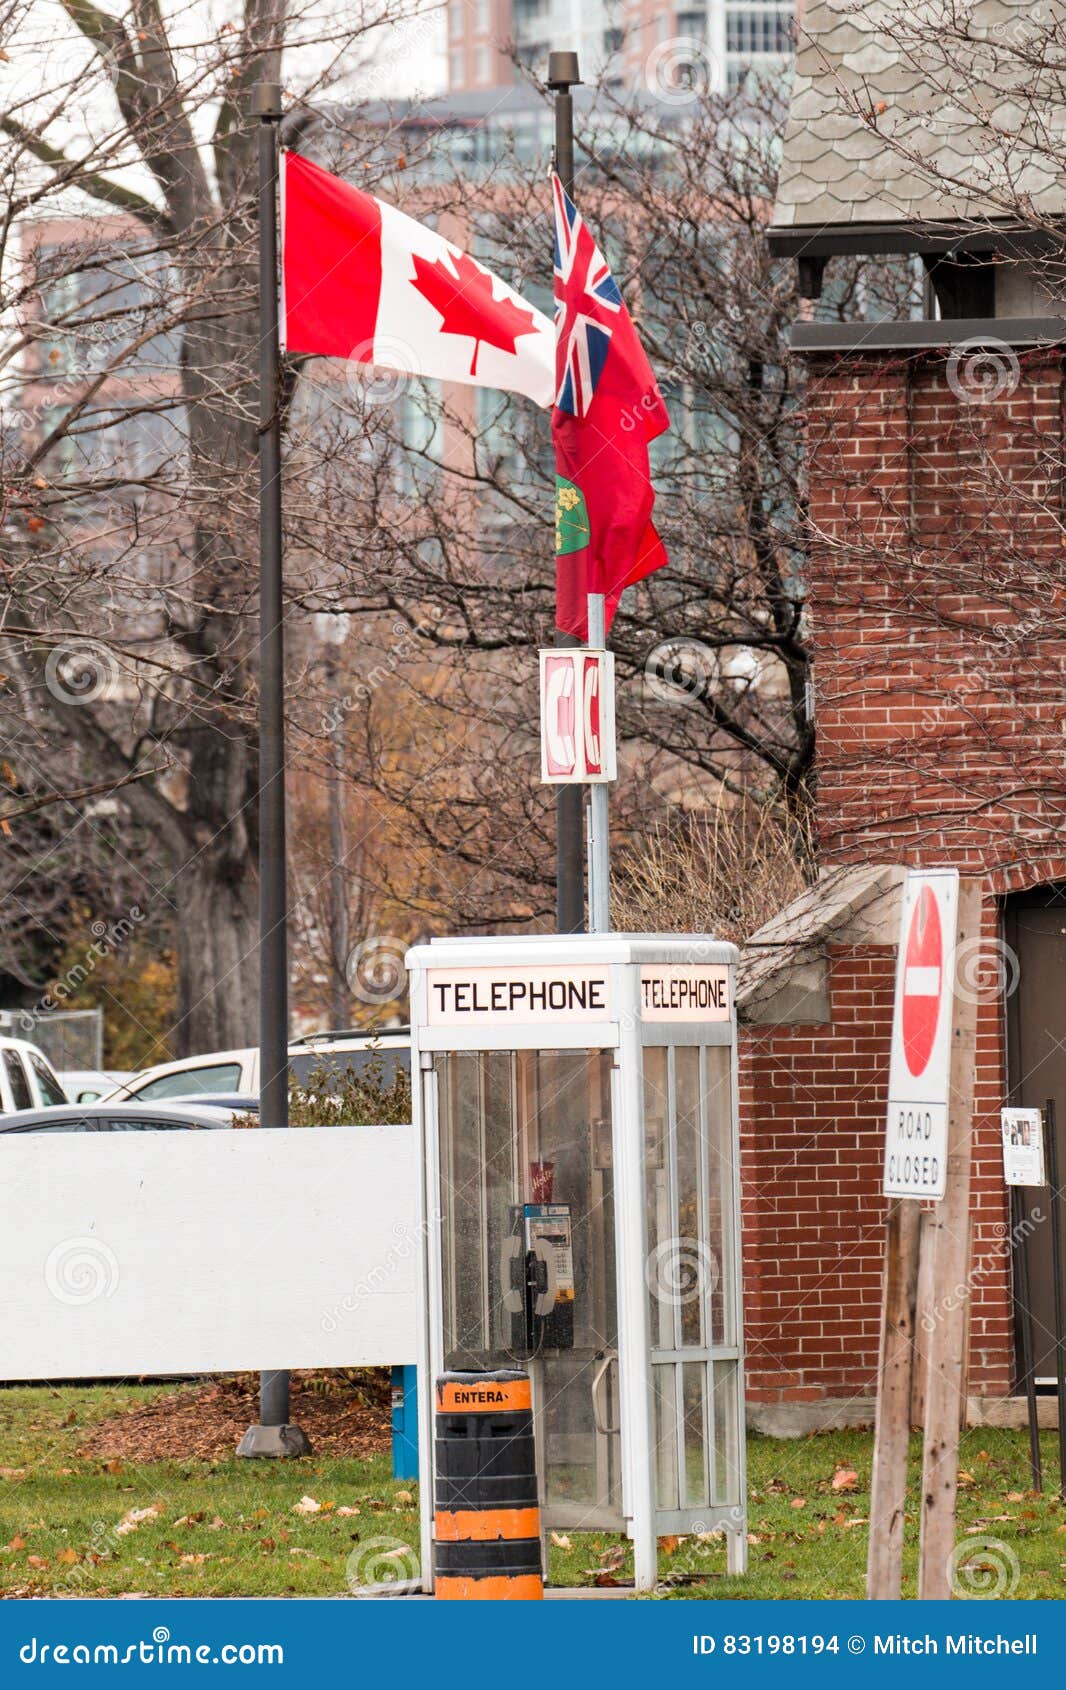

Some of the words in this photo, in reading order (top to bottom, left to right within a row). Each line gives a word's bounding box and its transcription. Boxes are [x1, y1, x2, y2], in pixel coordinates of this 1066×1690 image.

[433, 980, 605, 1012] TELEPHONE
[641, 980, 727, 1008] TELEPHONE
[898, 1111, 932, 1140] ROAD
[888, 1155, 938, 1184] CLOSED
